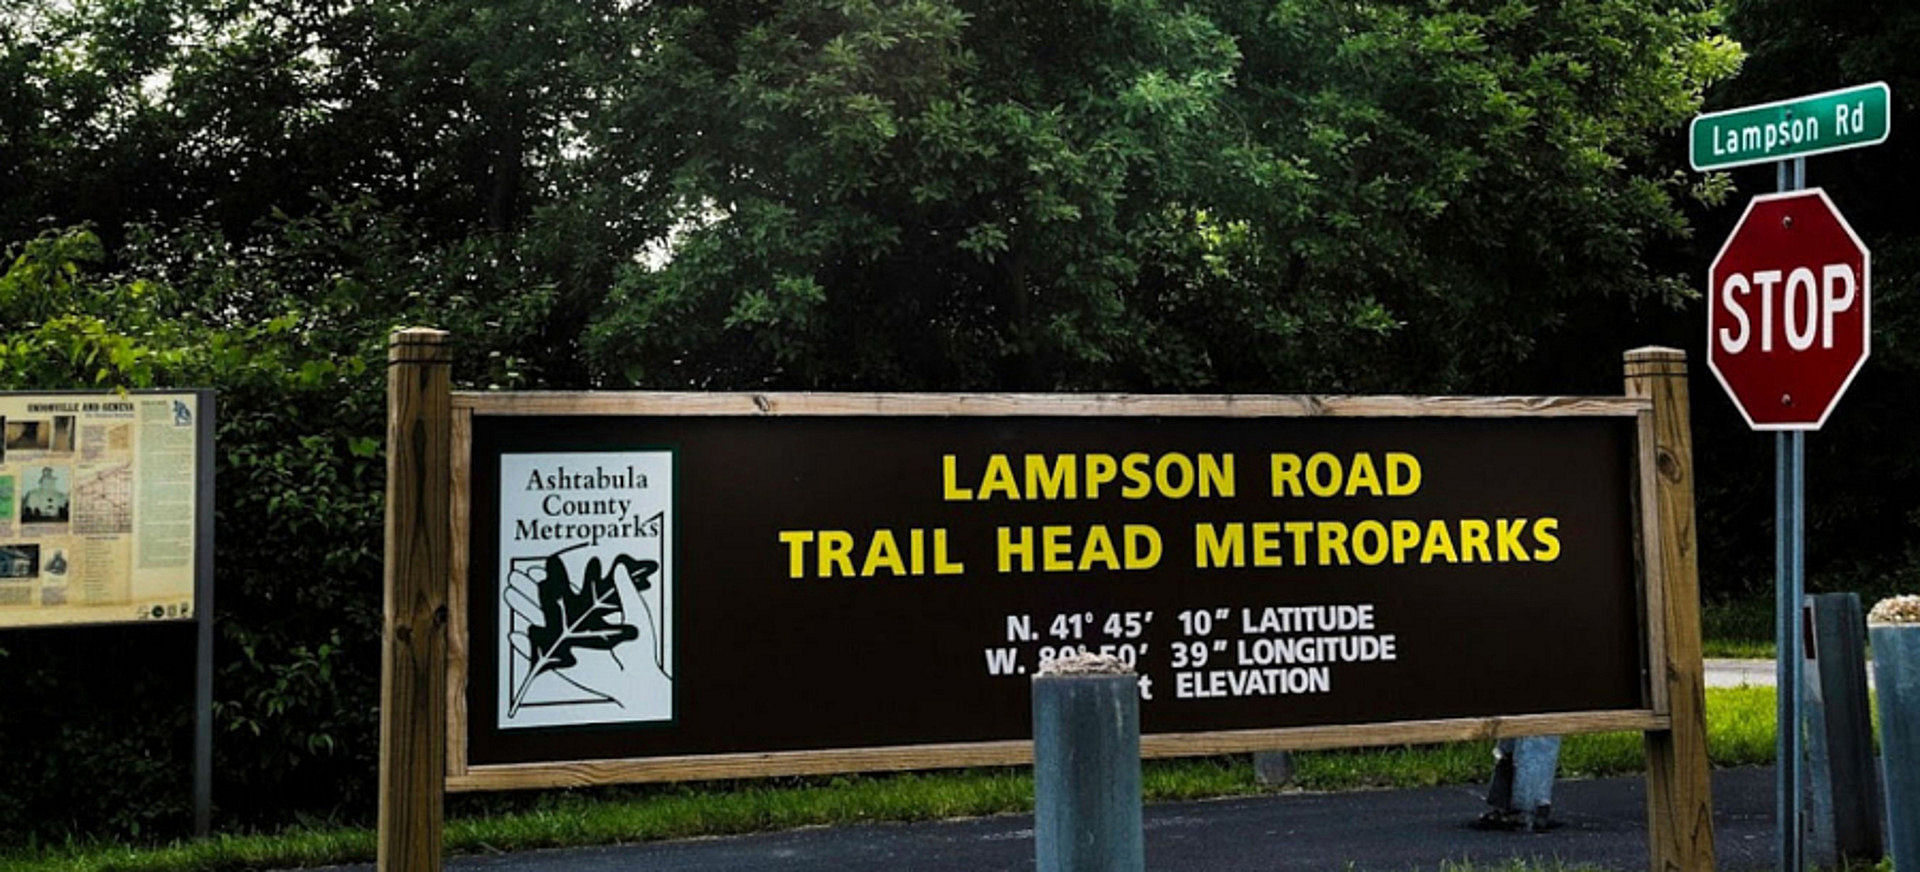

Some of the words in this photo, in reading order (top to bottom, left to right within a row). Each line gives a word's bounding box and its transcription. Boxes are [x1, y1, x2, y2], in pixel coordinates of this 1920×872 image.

[1713, 115, 1818, 156] Lampson
[1835, 101, 1864, 136] Rd
[1719, 263, 1856, 354] STOP
[526, 465, 648, 491] Ashtabula
[942, 452, 1236, 501] LAMPSON
[1270, 451, 1422, 498] ROAD
[542, 494, 631, 521] County
[514, 515, 660, 546] Metroparks
[779, 528, 964, 579] TRAIL
[997, 524, 1163, 573] HEAD
[1195, 517, 1561, 568] METROPARKS
[1007, 614, 1039, 642] N.
[1243, 604, 1375, 634] LATITUDE
[985, 647, 1026, 675] W.
[1237, 635, 1397, 666] LONGITUDE
[1175, 667, 1330, 698] ELEVATION
